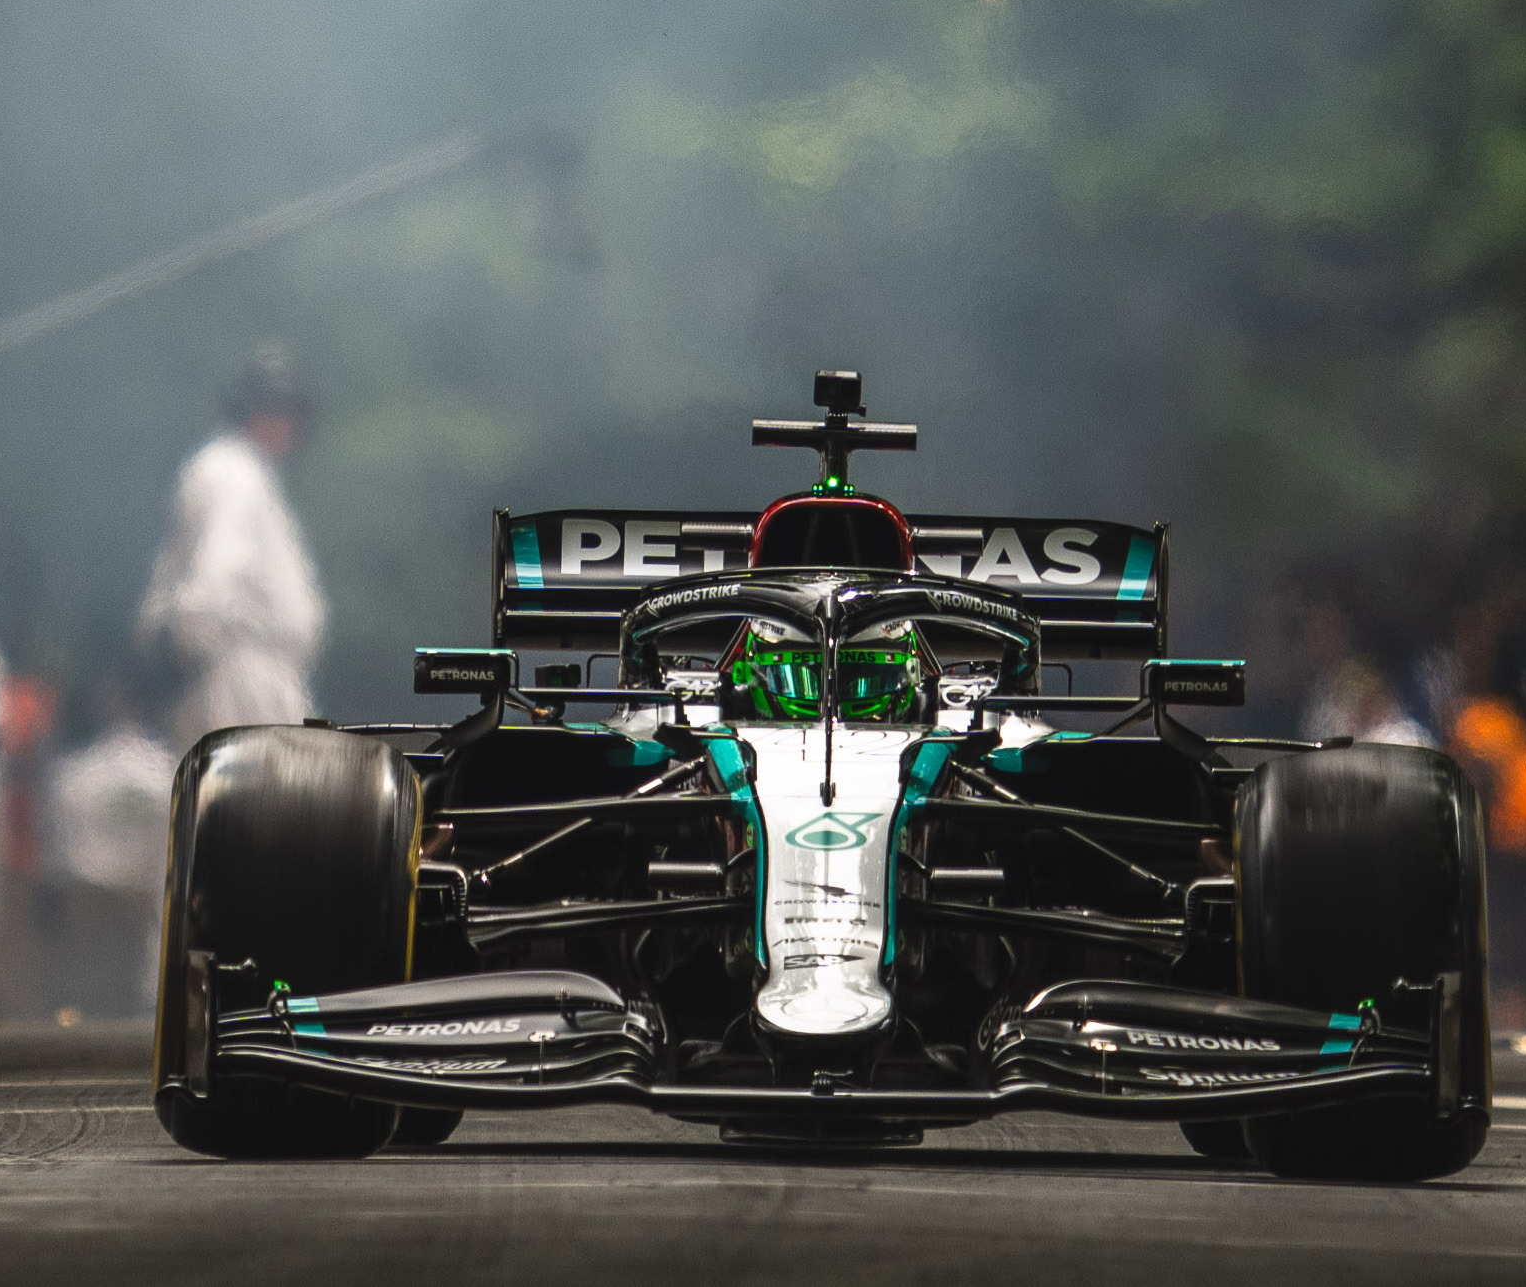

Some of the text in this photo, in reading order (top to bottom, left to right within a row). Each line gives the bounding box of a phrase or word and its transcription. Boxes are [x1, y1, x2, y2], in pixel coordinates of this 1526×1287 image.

[651, 583, 741, 610] CROWDSTRIKE
[933, 591, 1018, 621] CROWDSTRIKE
[792, 651, 877, 663] PETONAS
[430, 669, 495, 681] PETRONAS
[1163, 681, 1228, 692] PETRONAS
[366, 1018, 522, 1036] PETRONAS
[1126, 1030, 1281, 1051] PETRONAS
